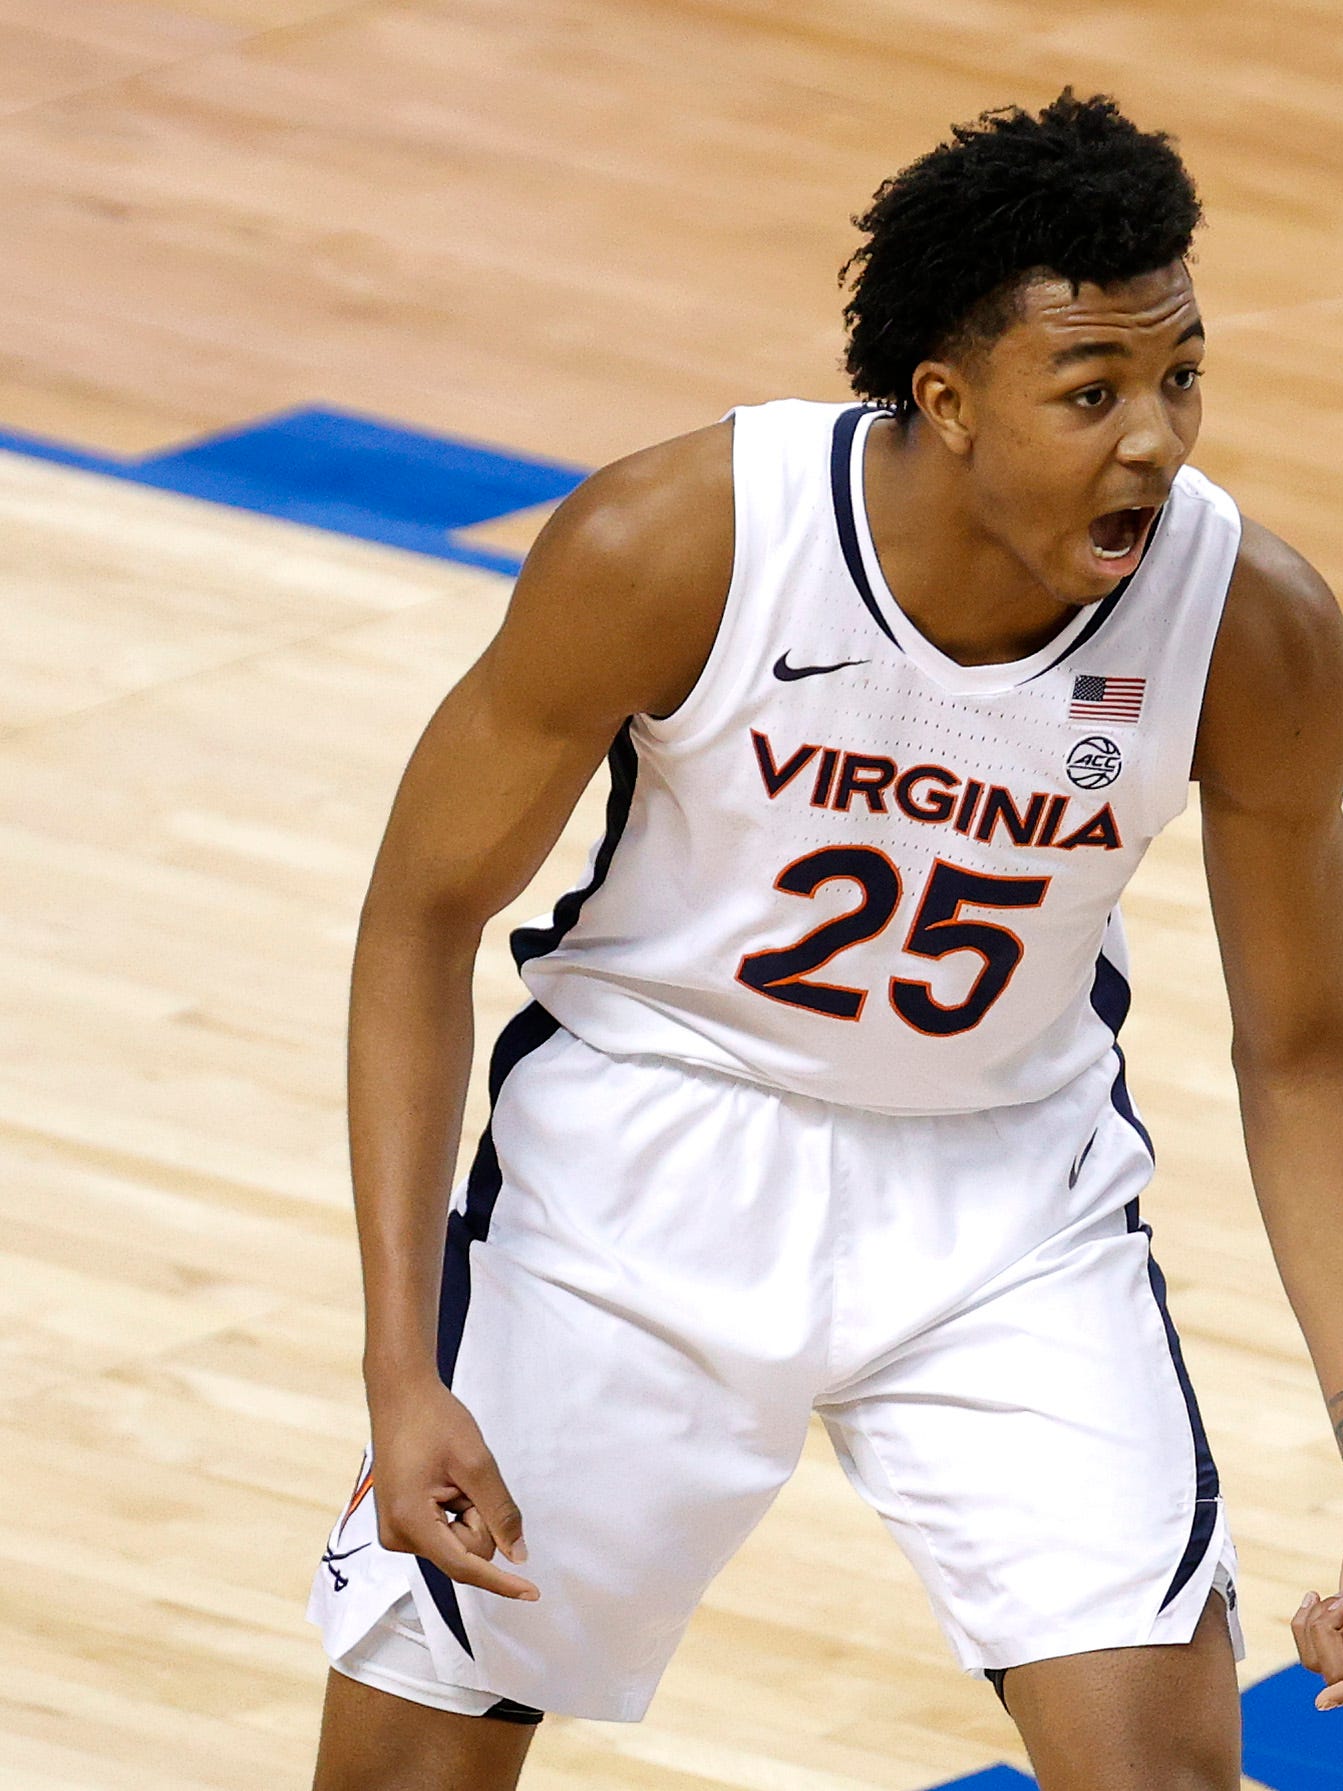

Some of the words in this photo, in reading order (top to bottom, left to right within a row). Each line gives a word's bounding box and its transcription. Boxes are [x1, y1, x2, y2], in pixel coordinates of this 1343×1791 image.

[750, 728, 1124, 850] VIRGINIA
[1073, 754, 1121, 769] ACC
[735, 844, 1052, 1037] 25
